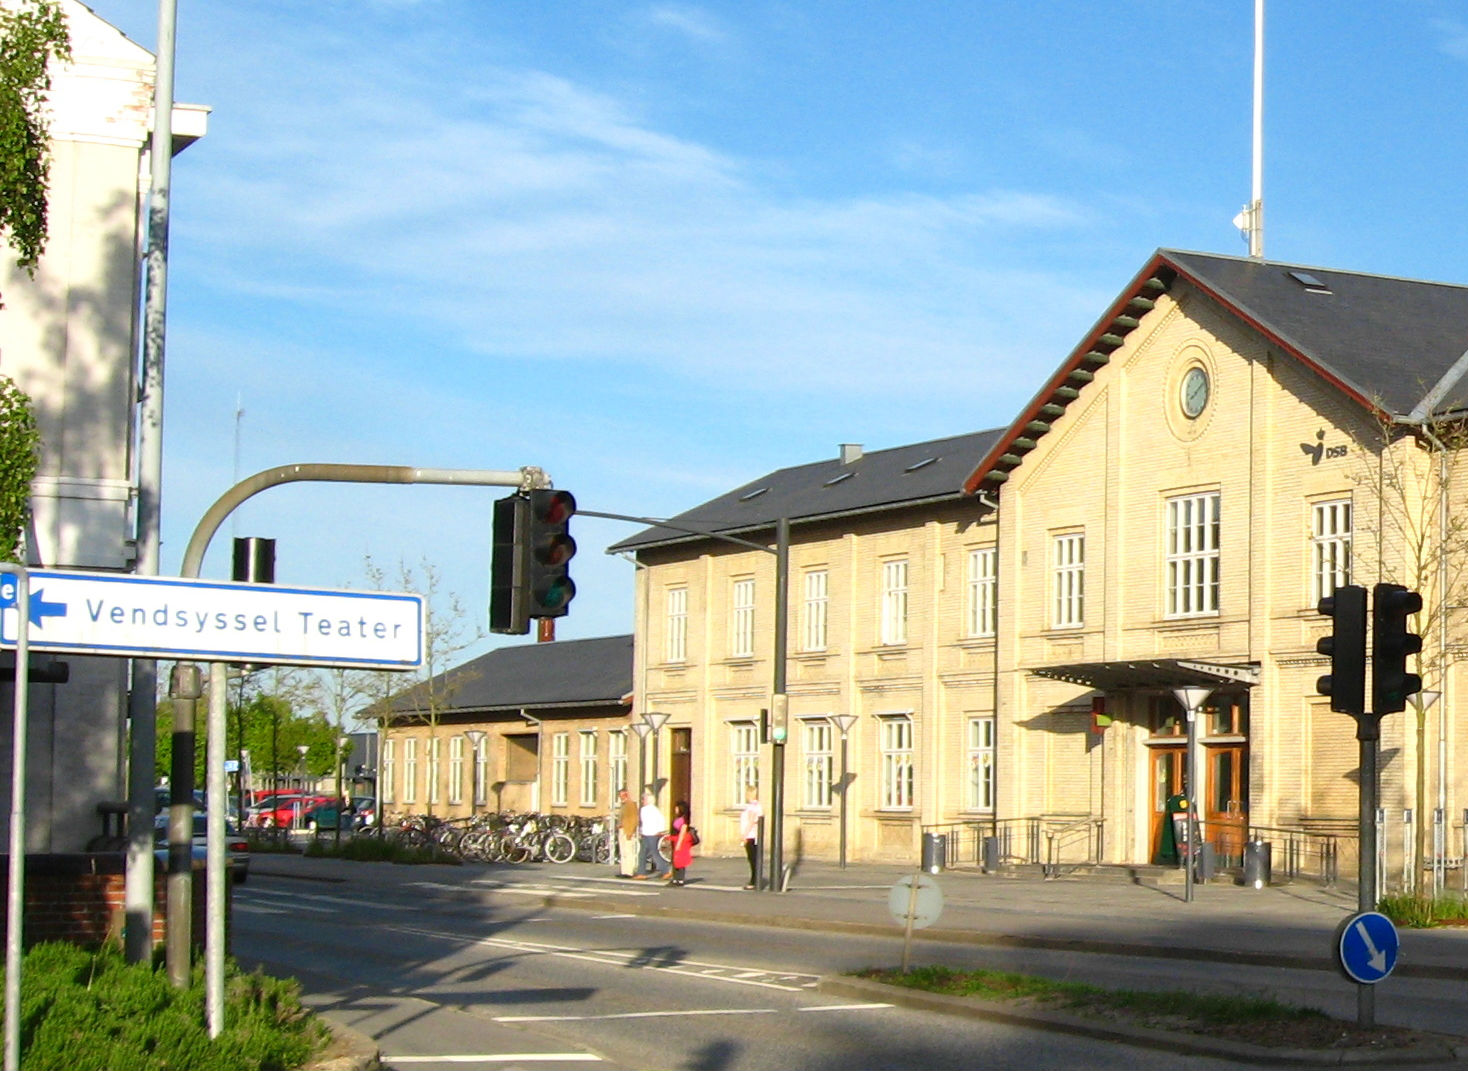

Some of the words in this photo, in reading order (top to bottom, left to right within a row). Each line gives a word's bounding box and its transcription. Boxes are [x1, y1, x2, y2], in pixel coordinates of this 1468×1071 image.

[1326, 445, 1348, 459] DSB
[86, 598, 281, 633] Vendsyssel
[298, 612, 402, 639] Teater
